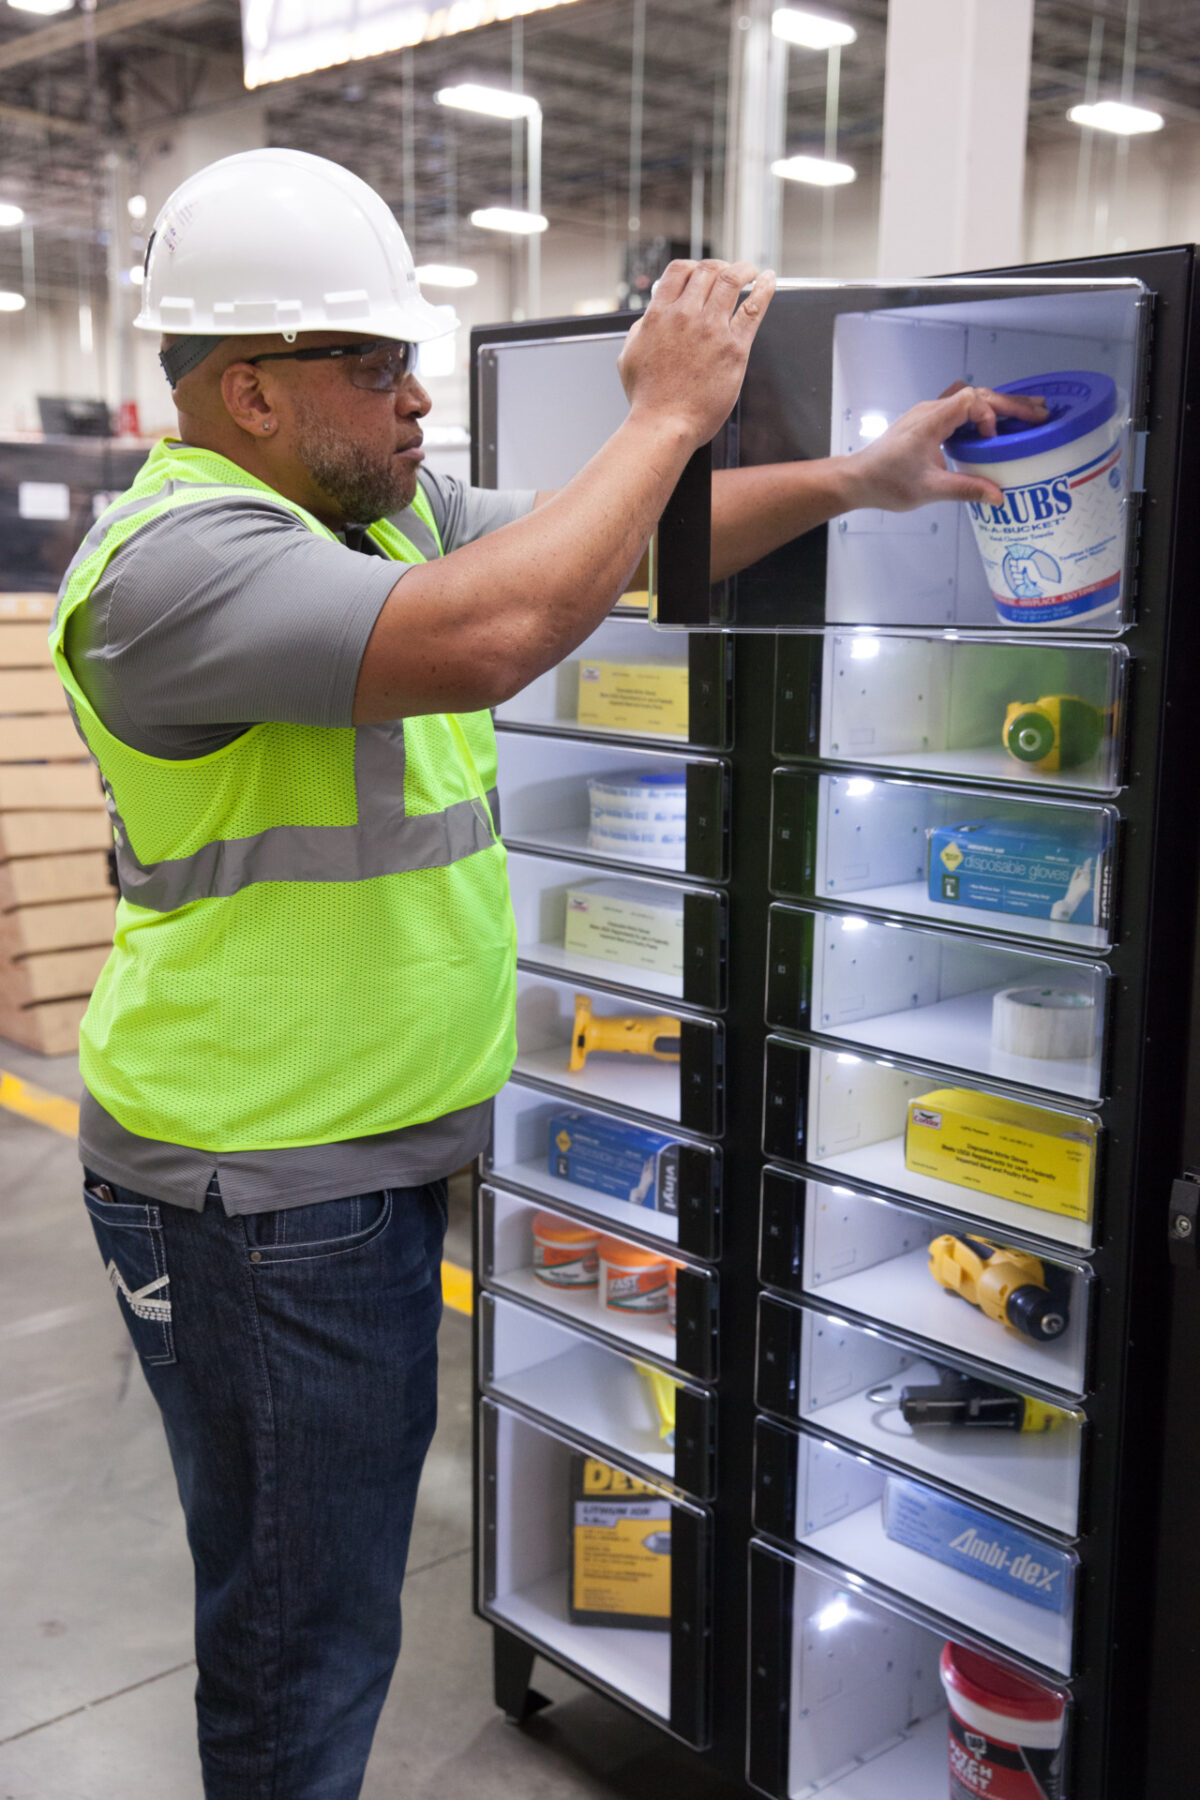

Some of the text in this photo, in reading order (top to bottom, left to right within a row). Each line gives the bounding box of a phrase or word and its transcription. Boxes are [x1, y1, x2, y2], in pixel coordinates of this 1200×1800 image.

[964, 855, 1026, 875] disposable
[1028, 865, 1070, 881] gloves
[946, 884, 955, 897] L
[950, 1528, 1060, 1591] Ambi-dex
